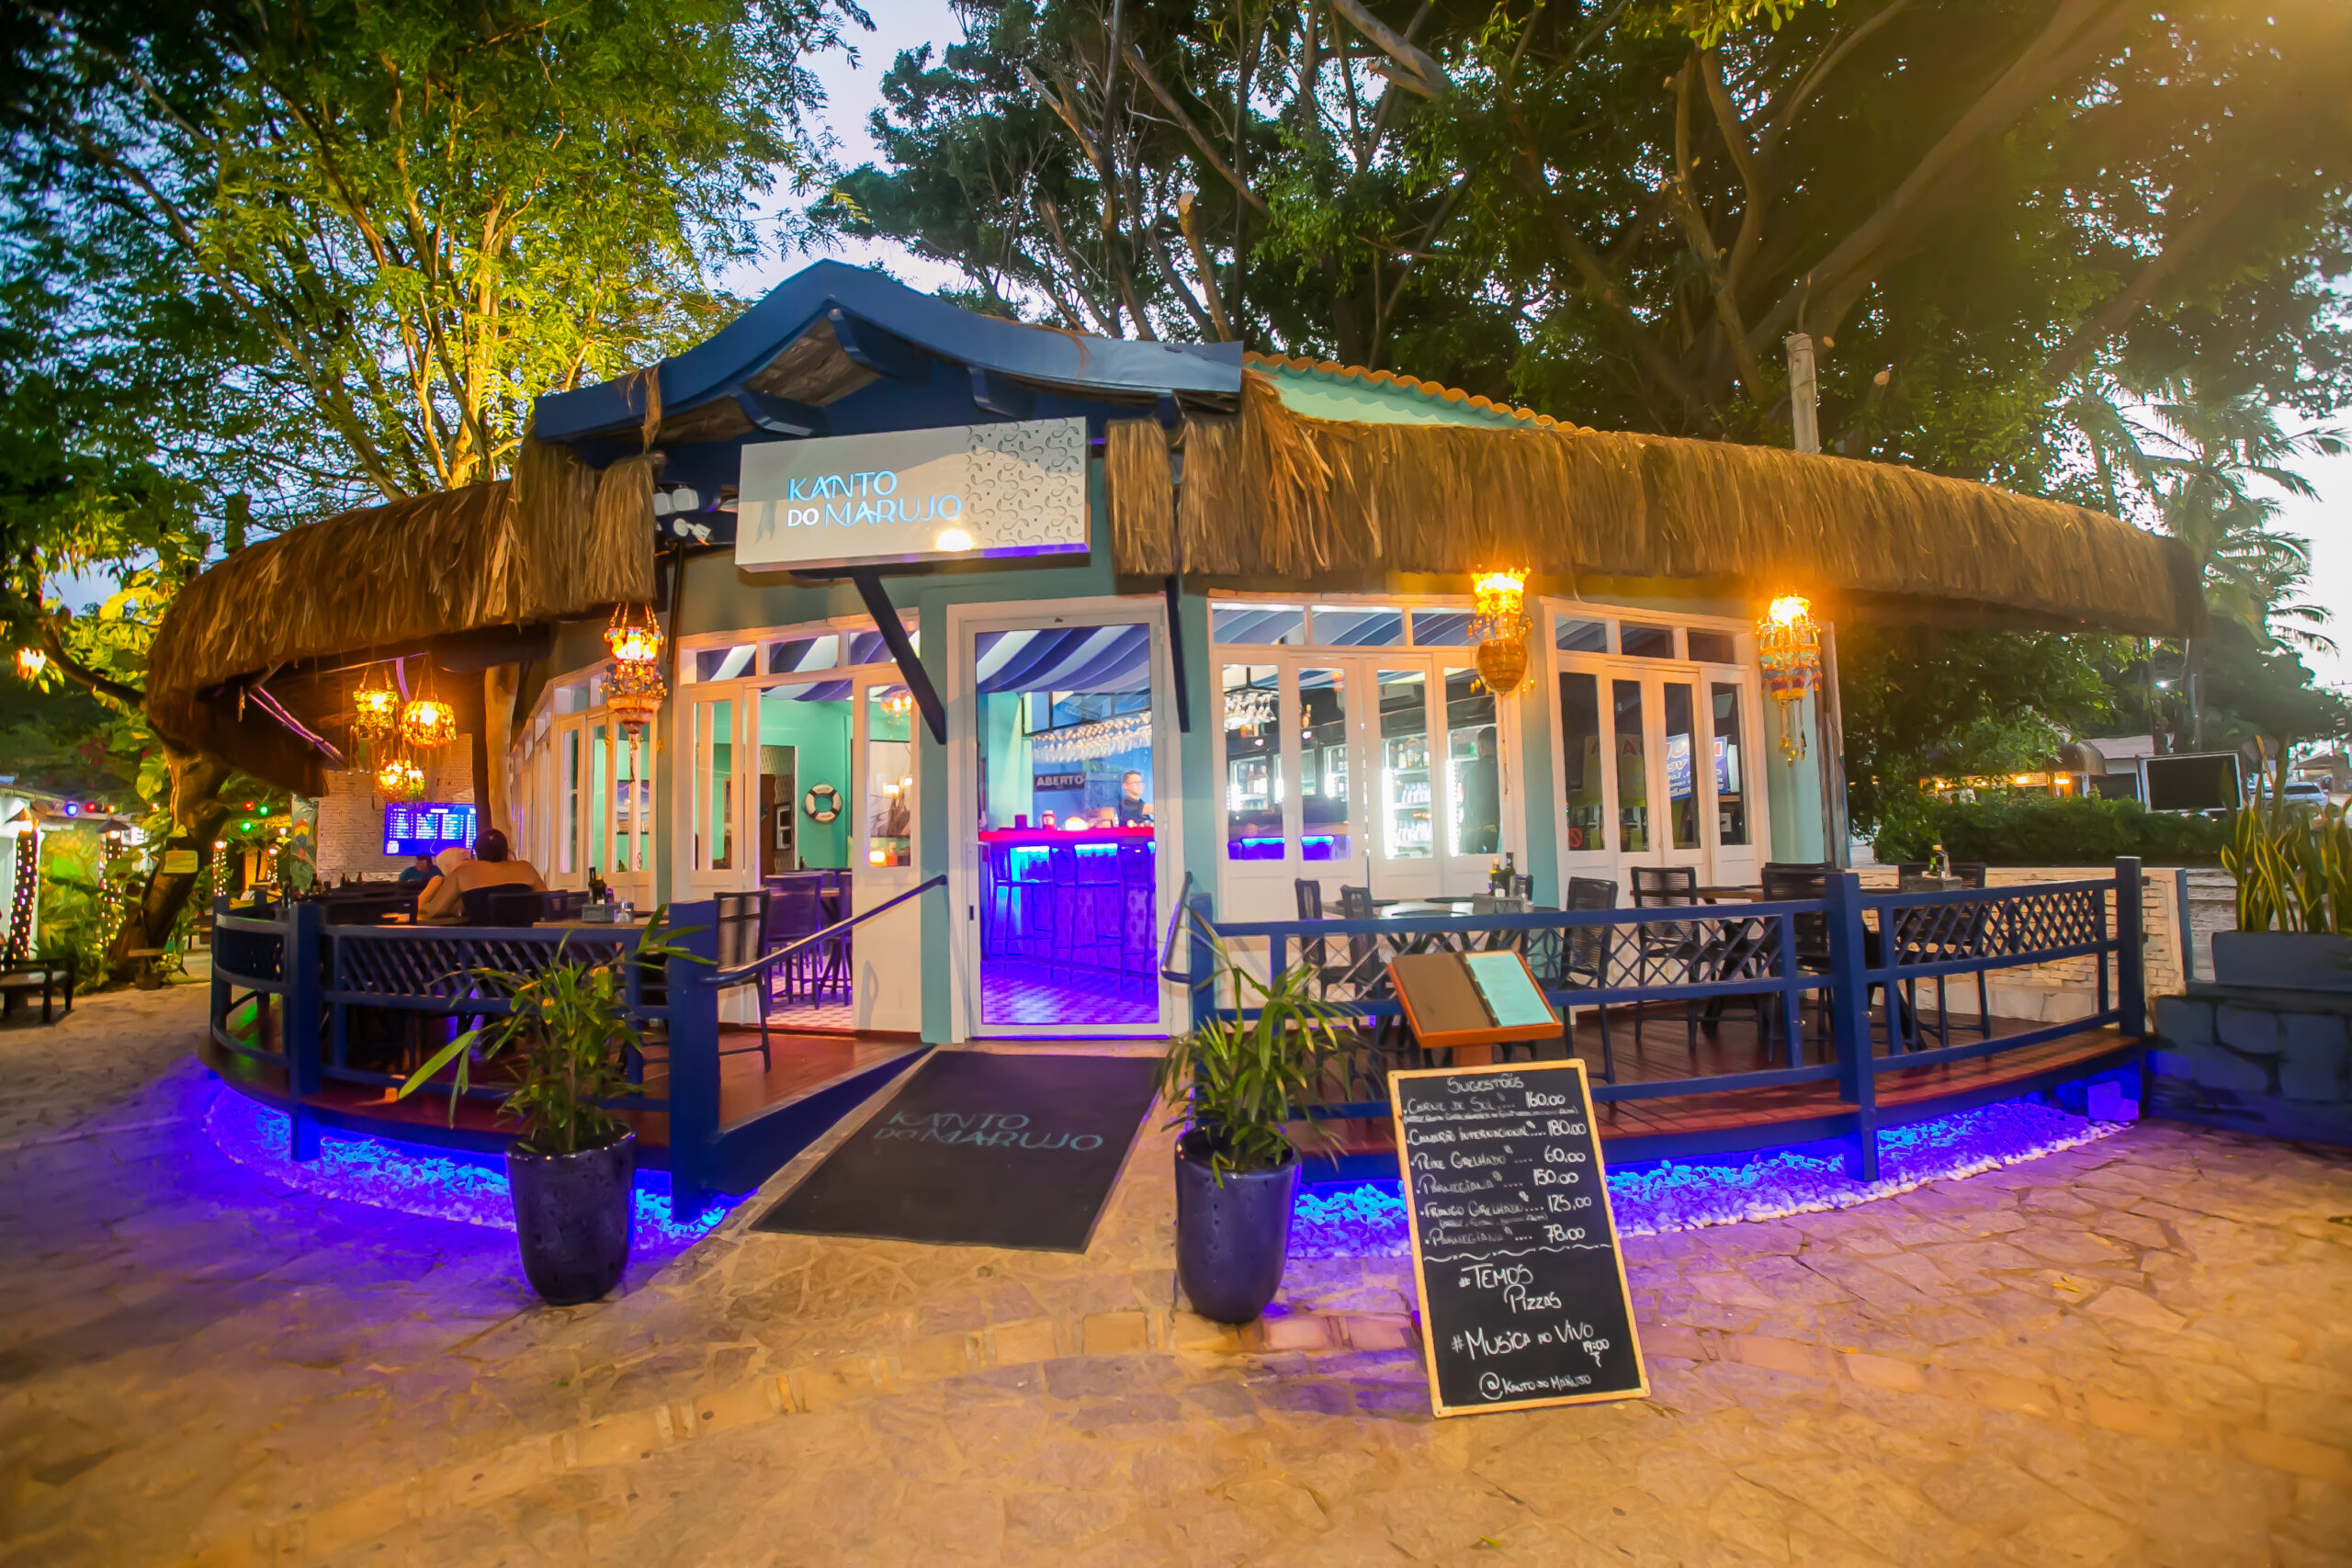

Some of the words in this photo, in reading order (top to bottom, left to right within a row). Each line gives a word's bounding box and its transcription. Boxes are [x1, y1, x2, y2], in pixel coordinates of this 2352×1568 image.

[787, 470, 898, 502] KANTO
[786, 507, 820, 527] DO
[824, 494, 962, 527] MARUJO
[1036, 774, 1085, 786] ABERTO
[888, 1111, 1030, 1129] KANTO
[874, 1128, 918, 1139] DO
[920, 1129, 1102, 1150] MARUJO
[1413, 1152, 1446, 1170] PEIXE
[1450, 1150, 1507, 1168] GRELHADO
[1582, 1338, 1610, 1353] 19:00
